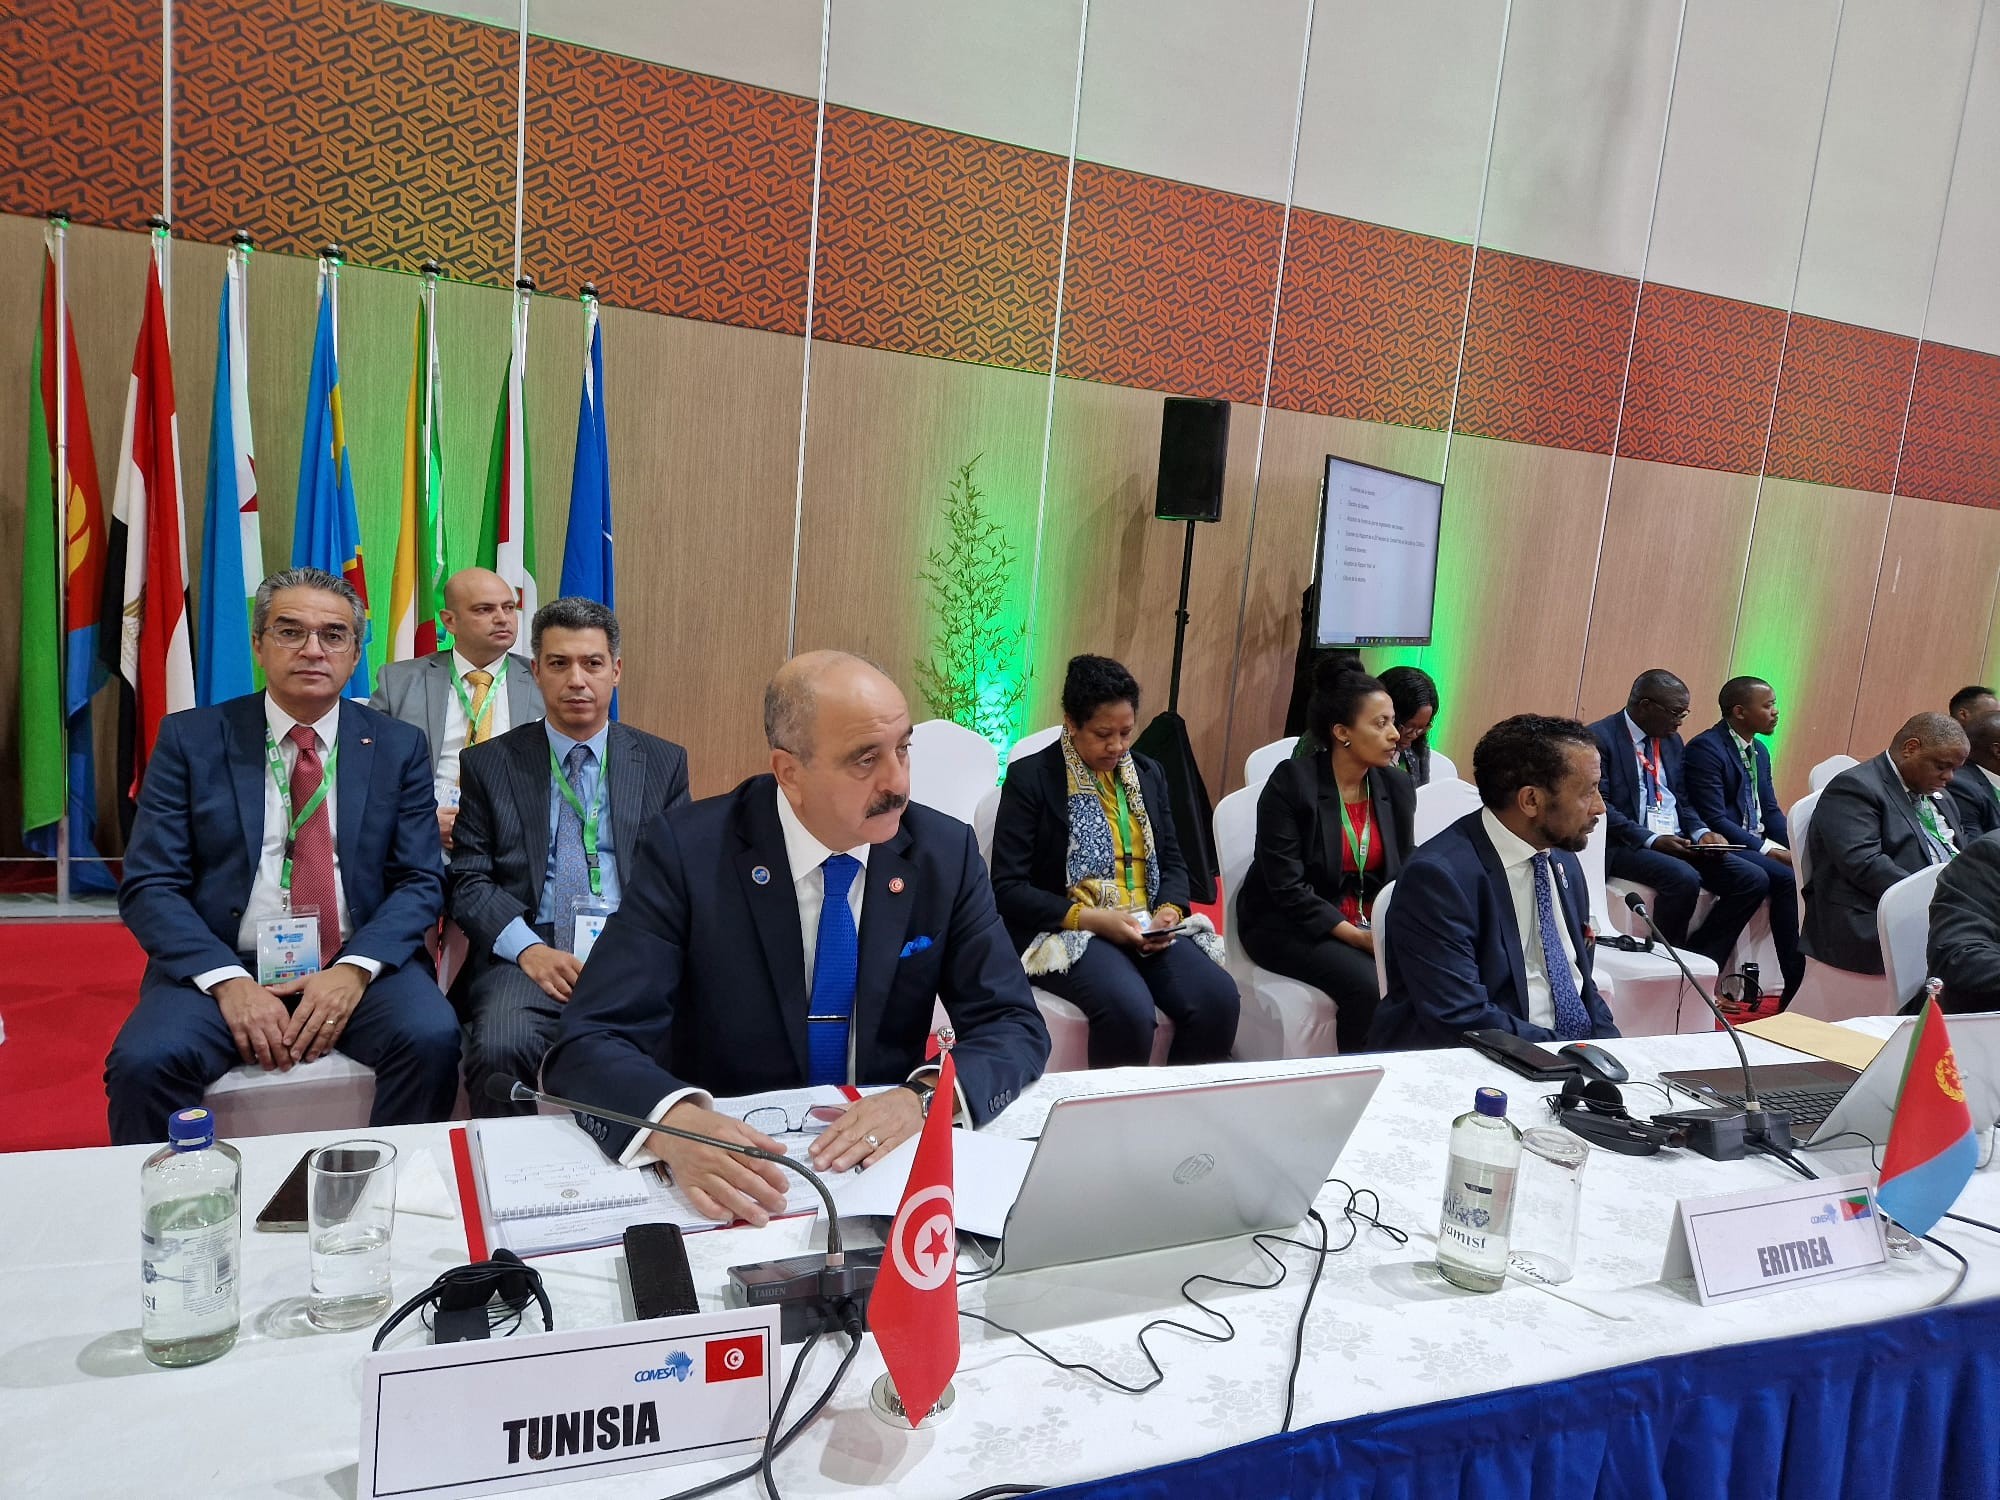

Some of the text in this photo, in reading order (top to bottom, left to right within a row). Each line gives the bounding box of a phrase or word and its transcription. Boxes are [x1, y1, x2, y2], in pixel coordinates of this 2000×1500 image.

[1757, 1236, 1833, 1277] ERITREA
[753, 1286, 788, 1298] TAIDEN
[634, 1364, 677, 1383] COMESA
[502, 1400, 661, 1464] TUNISIA
